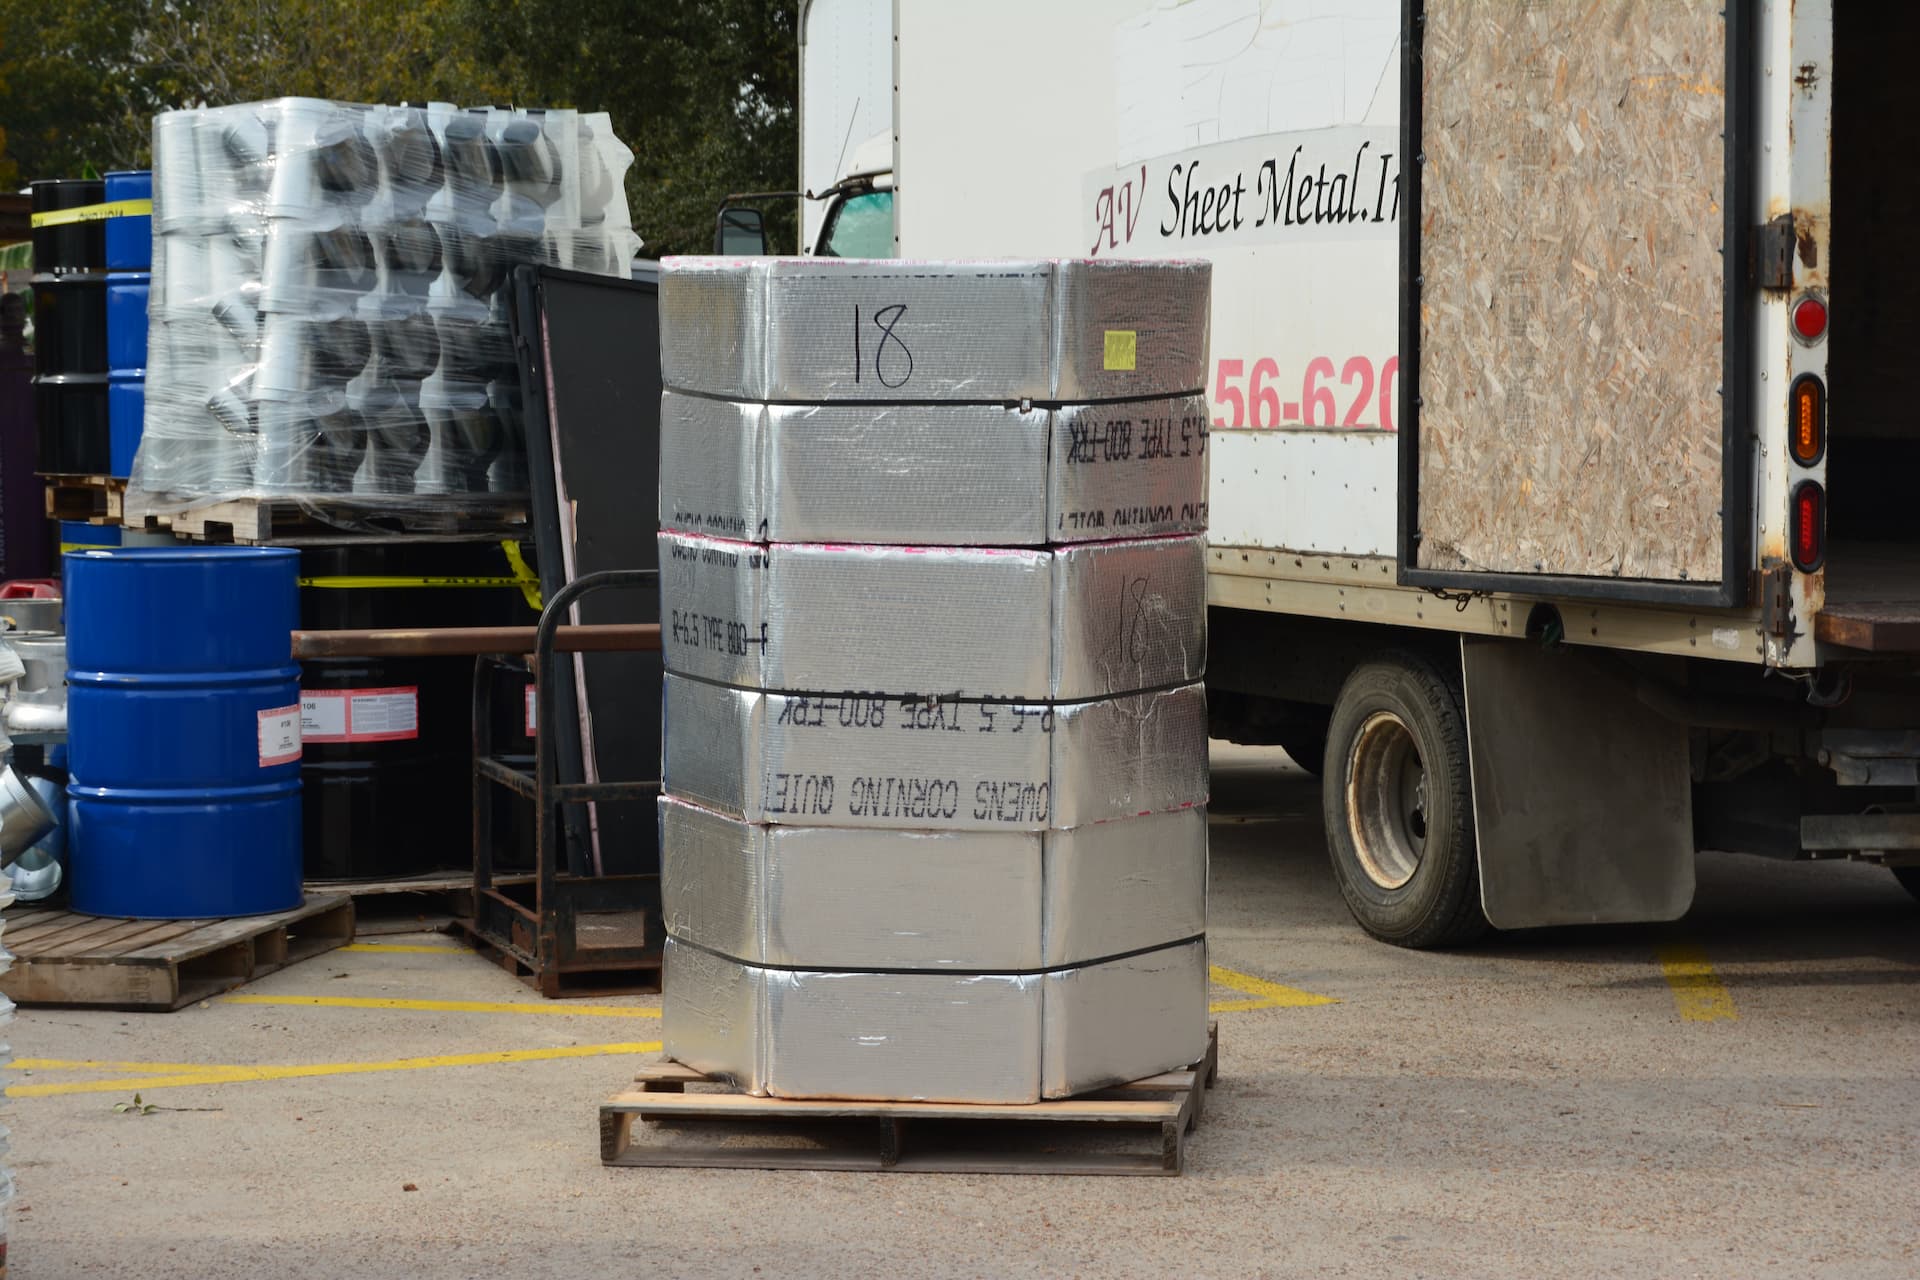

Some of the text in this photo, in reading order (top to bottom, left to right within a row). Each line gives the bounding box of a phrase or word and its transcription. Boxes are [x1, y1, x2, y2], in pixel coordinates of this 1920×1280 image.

[1091, 164, 1147, 256] AV
[1160, 160, 1247, 239] Sheet
[855, 304, 913, 388] 18
[1138, 418, 1173, 460] TYPE
[703, 615, 724, 652] TYPE
[901, 691, 963, 731] TYPE
[849, 776, 960, 819] CORNING
[973, 780, 1050, 822] OWENS
